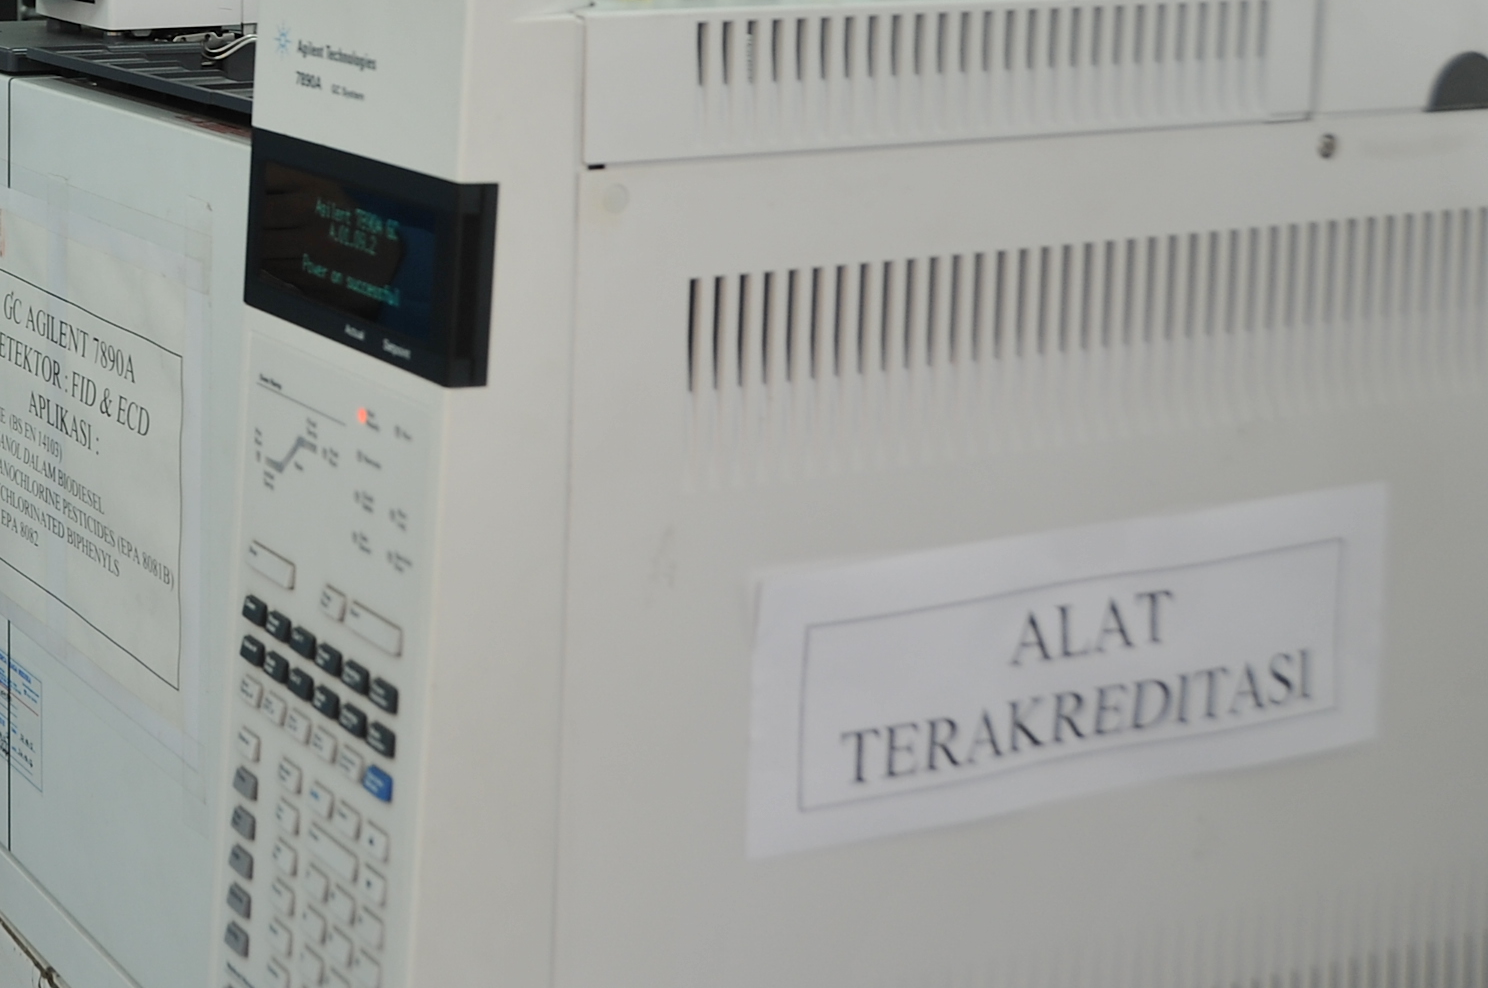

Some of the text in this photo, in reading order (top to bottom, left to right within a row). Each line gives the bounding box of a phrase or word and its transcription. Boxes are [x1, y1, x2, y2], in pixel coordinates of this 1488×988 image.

[296, 39, 377, 71] Agilent Technologies
[3, 293, 136, 384] GC AGILENT 7890A
[28, 390, 93, 451] APLIKASI
[71, 370, 97, 408] FID
[116, 394, 151, 437] ECD
[23, 447, 57, 483] DALAM
[57, 468, 105, 516] BIODIESEL
[0, 509, 19, 534] EPA
[19, 521, 39, 547] 8082
[62, 498, 116, 548] PESTICIDES
[66, 526, 121, 578] BIPHENYLS
[1008, 589, 1174, 667] ALAT
[840, 648, 1315, 783] TERAKREDITASI
